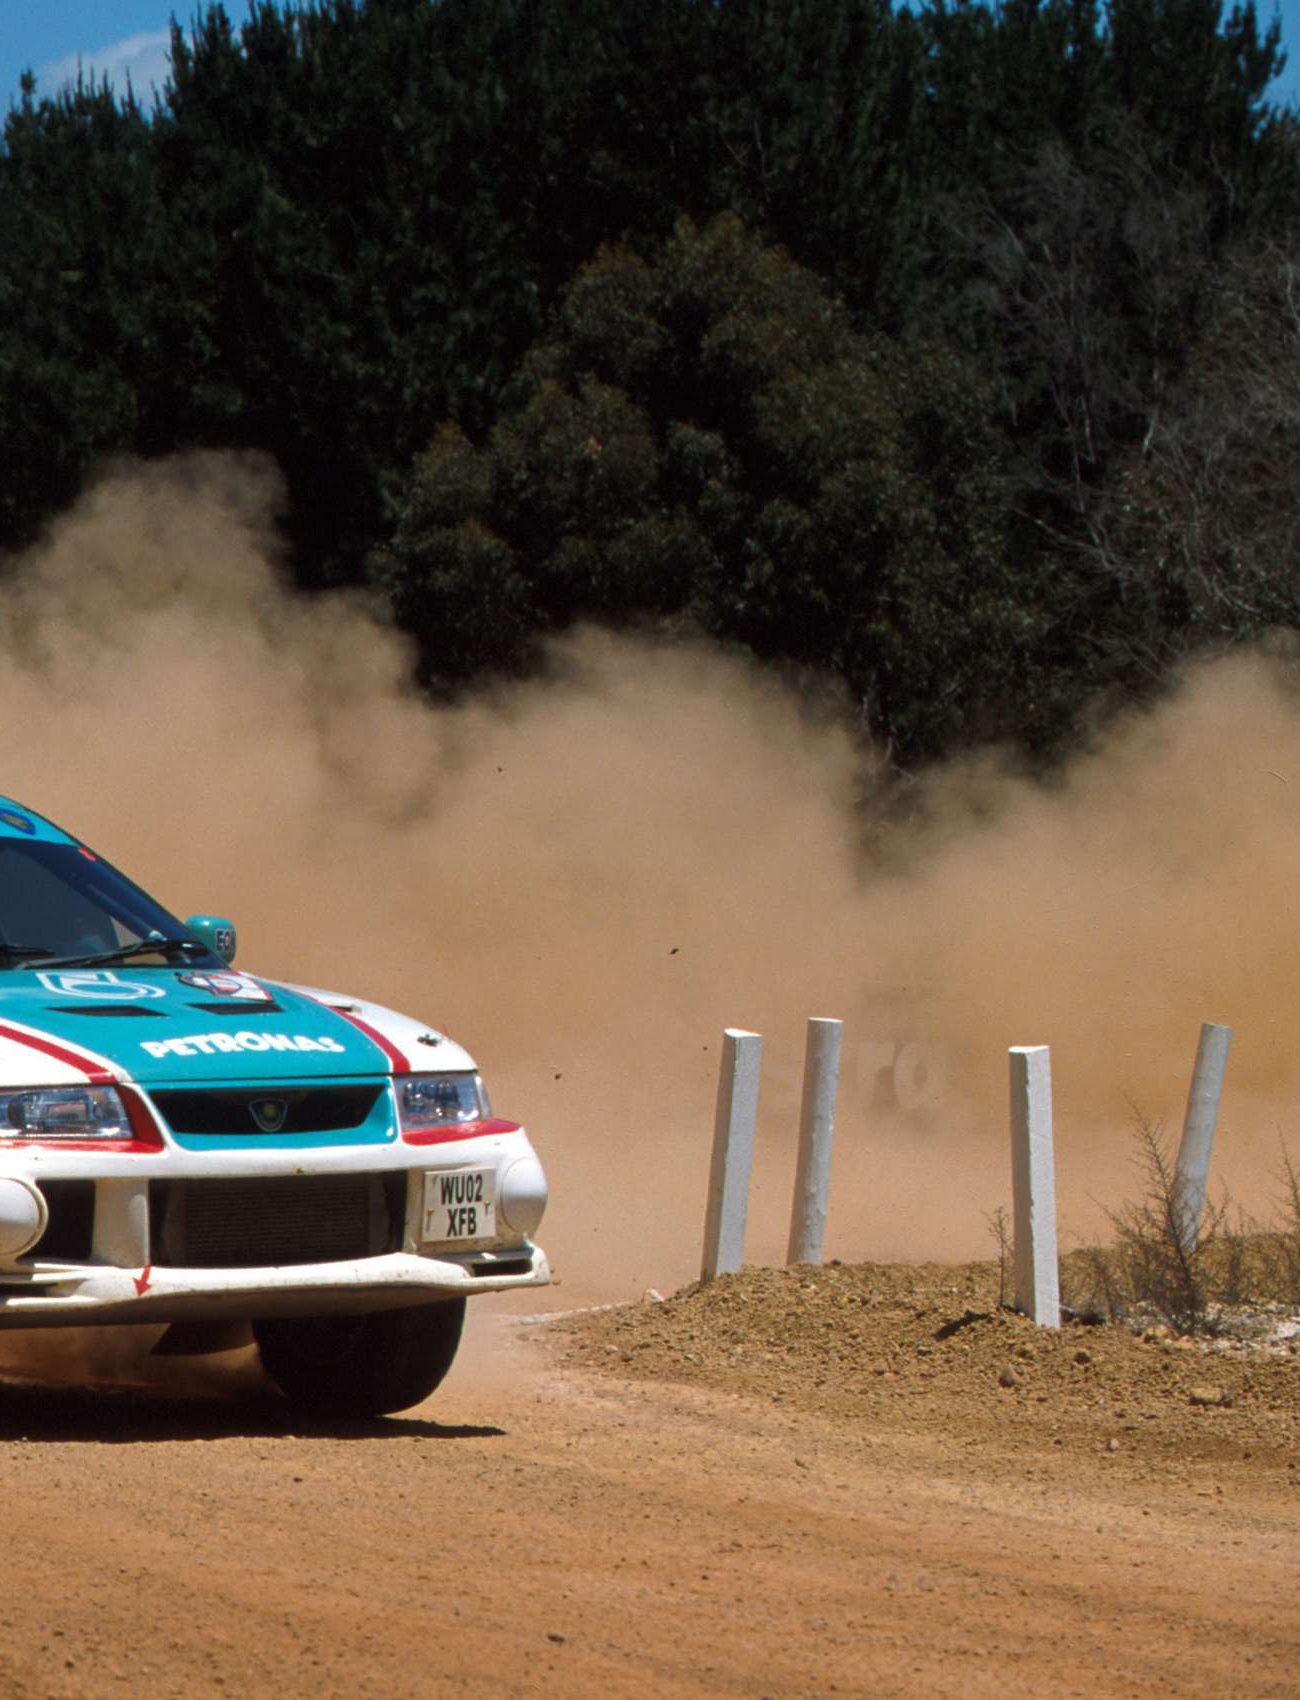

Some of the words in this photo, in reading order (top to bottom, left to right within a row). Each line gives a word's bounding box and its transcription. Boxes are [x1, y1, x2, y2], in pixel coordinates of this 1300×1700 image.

[214, 927, 236, 951] EO
[140, 1031, 345, 1058] PETRONAS
[440, 1173, 483, 1205] WU02
[447, 1207, 477, 1237] XFB
